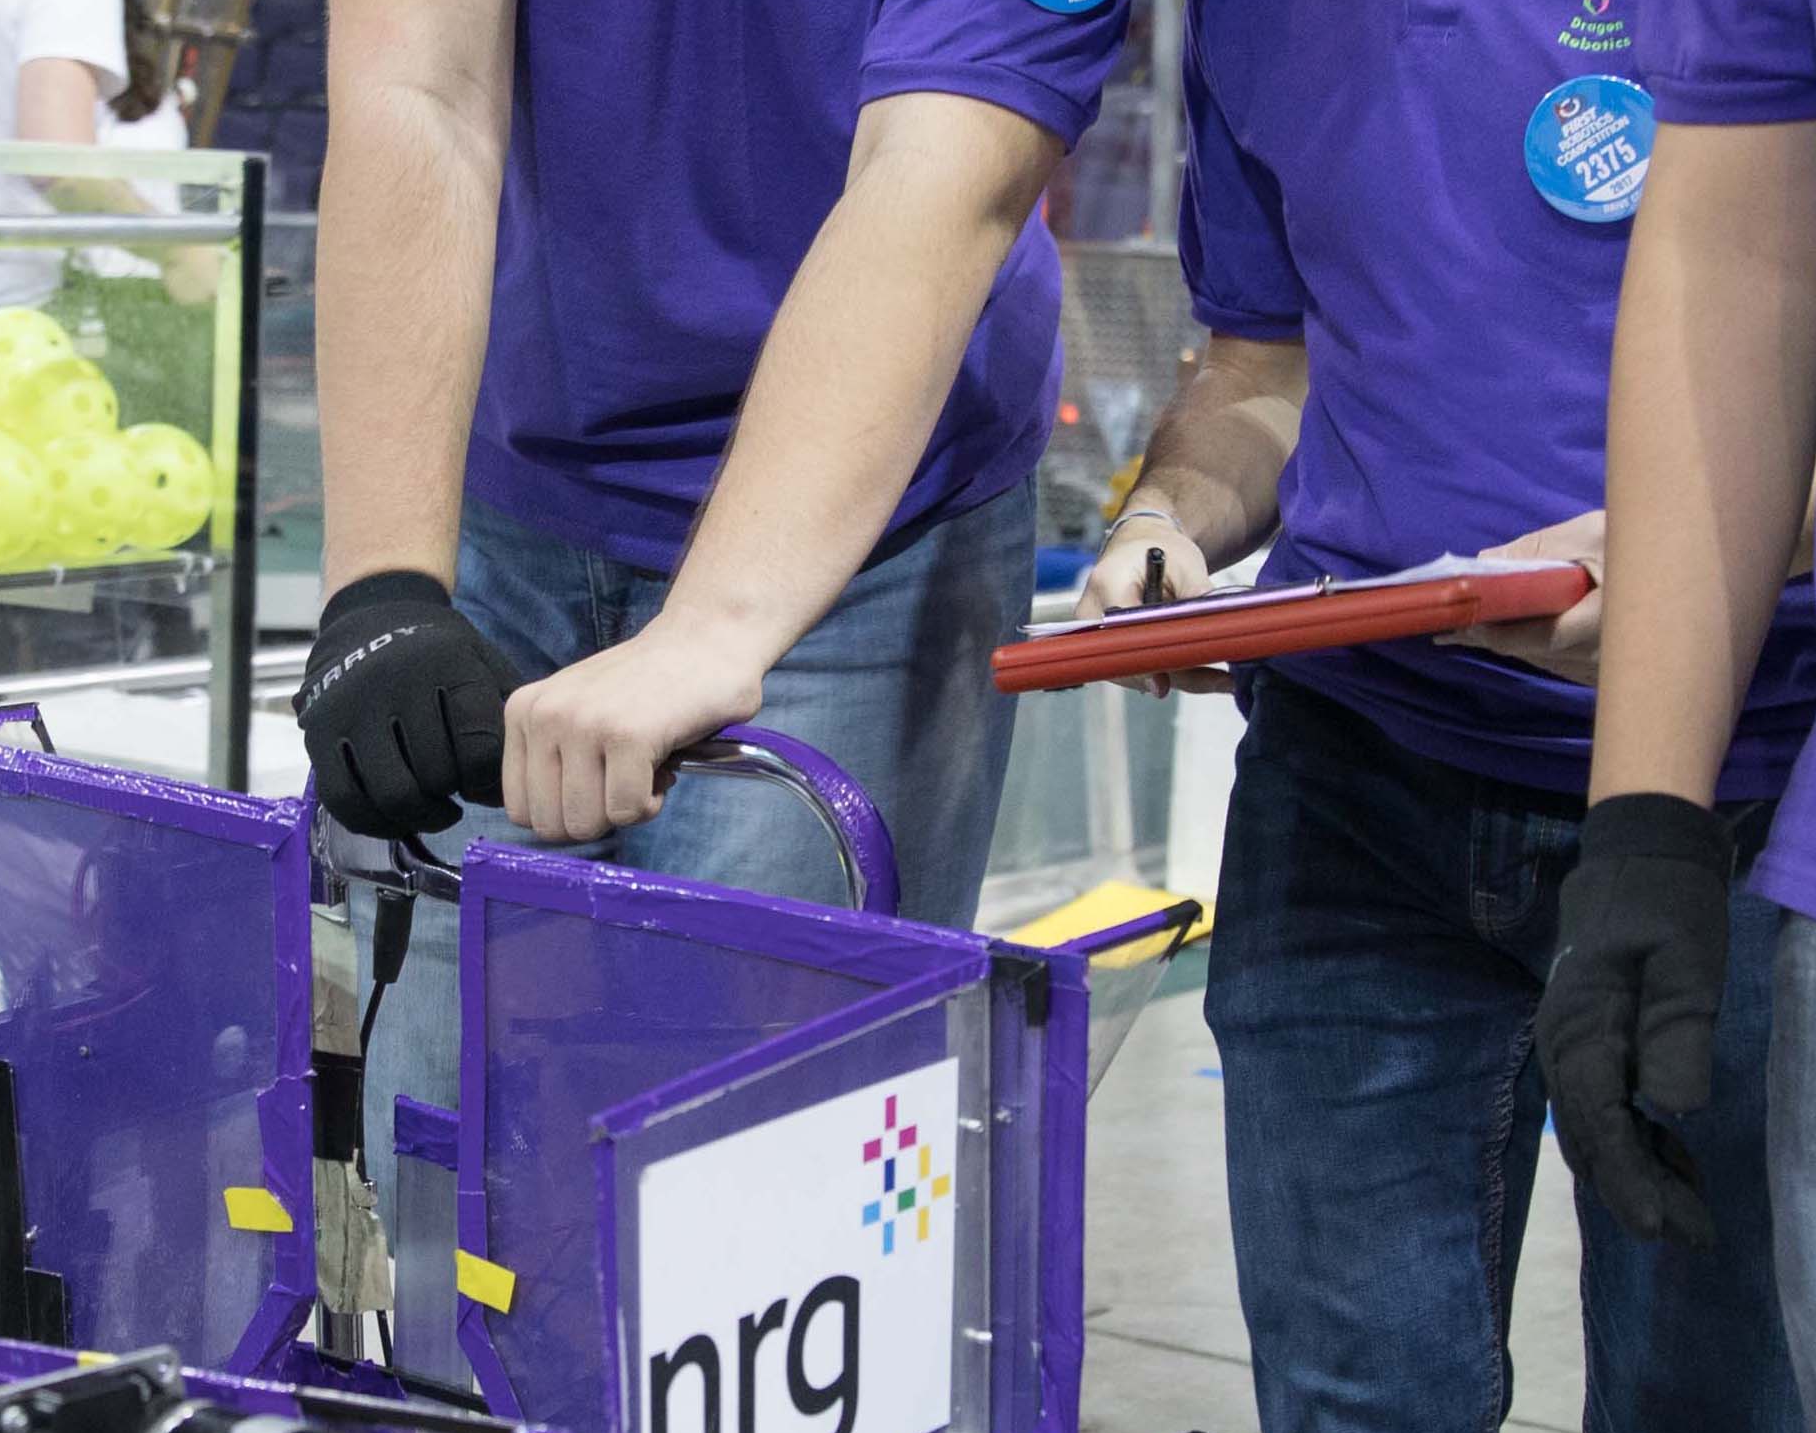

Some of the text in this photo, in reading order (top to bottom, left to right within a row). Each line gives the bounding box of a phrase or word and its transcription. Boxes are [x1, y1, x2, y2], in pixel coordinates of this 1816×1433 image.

[1557, 31, 1632, 51] Robotics
[1570, 16, 1624, 34] Dragon
[1575, 136, 1637, 188] 2375
[304, 626, 419, 711] HARDY
